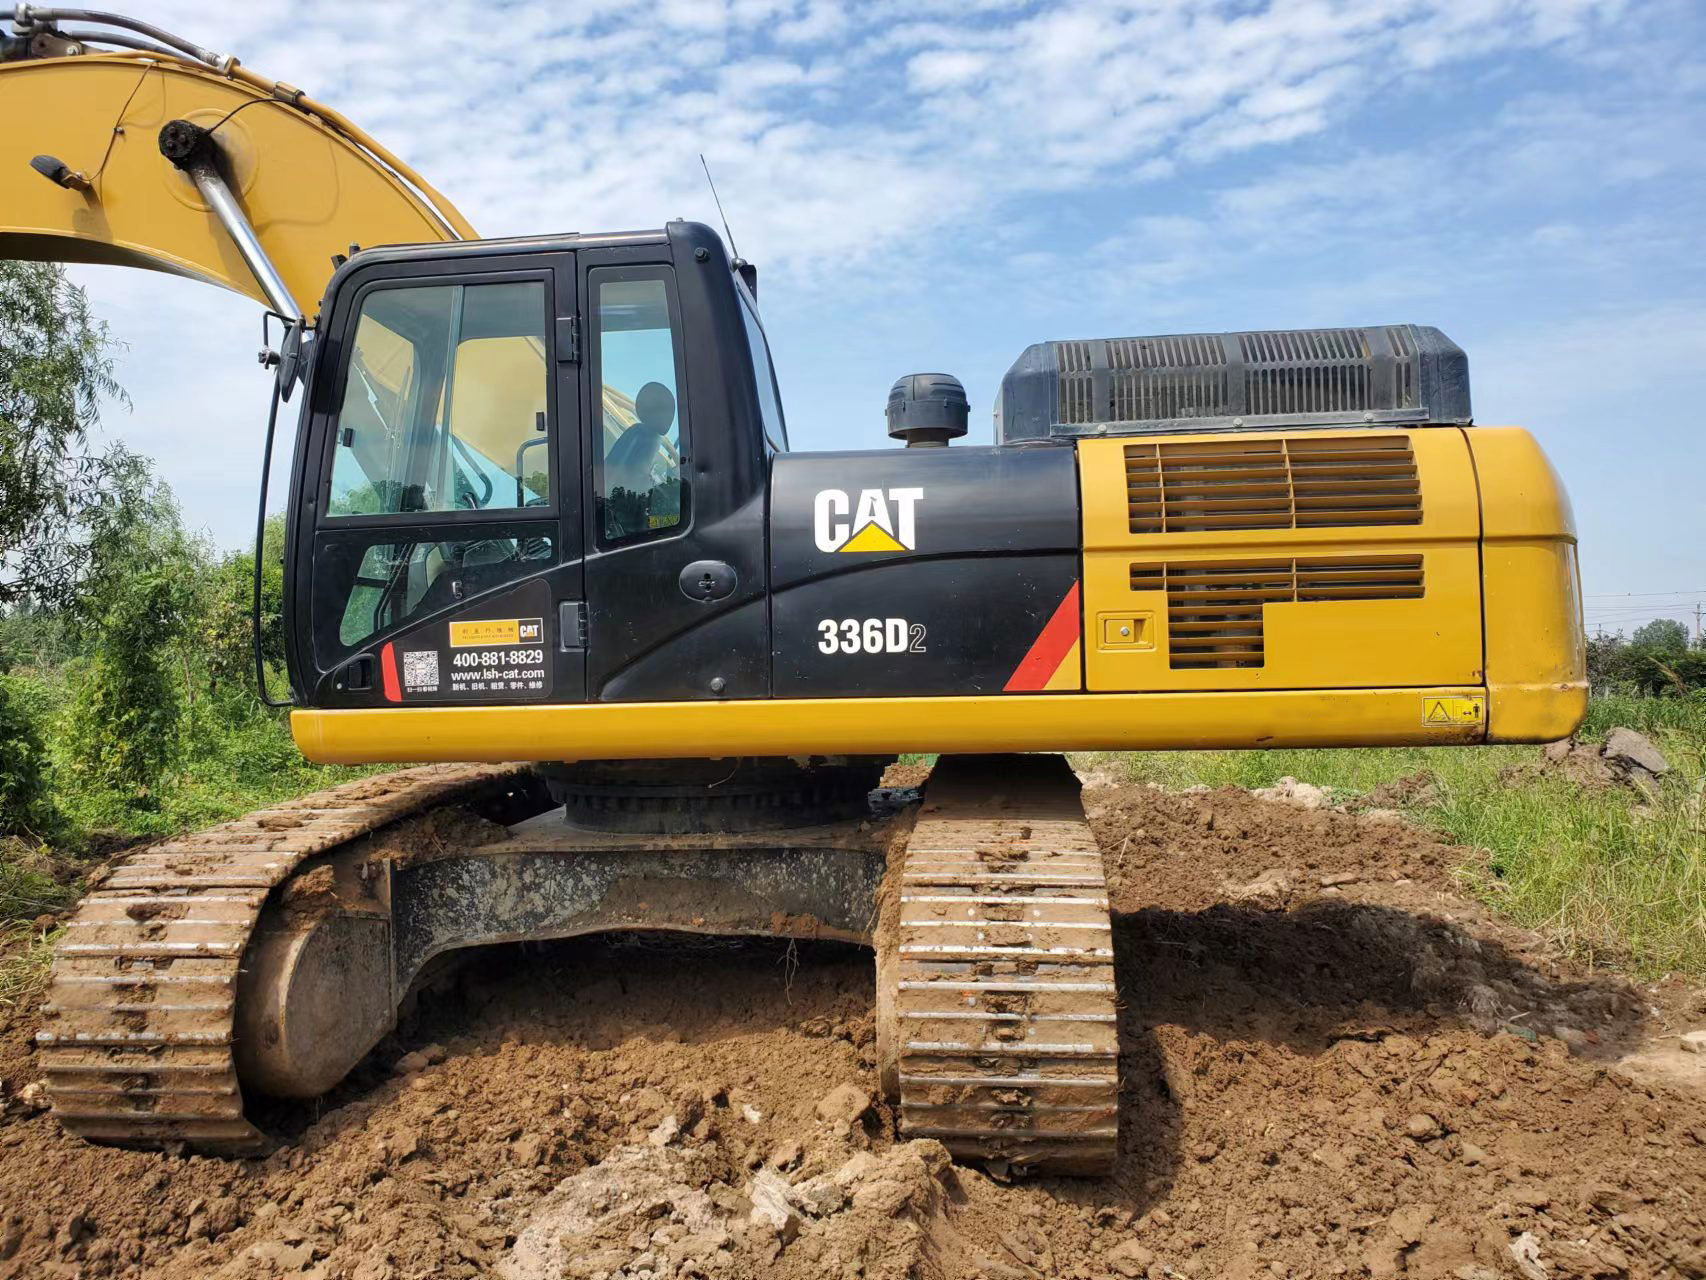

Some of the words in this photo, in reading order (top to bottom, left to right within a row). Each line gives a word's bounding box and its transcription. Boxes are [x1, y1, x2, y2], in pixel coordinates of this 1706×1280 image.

[814, 487, 923, 553] CAT
[520, 624, 539, 638] CAT
[817, 618, 927, 654] 336D2
[453, 650, 543, 667] 400-881-8829
[451, 668, 545, 681] www.lsh-cat.com
